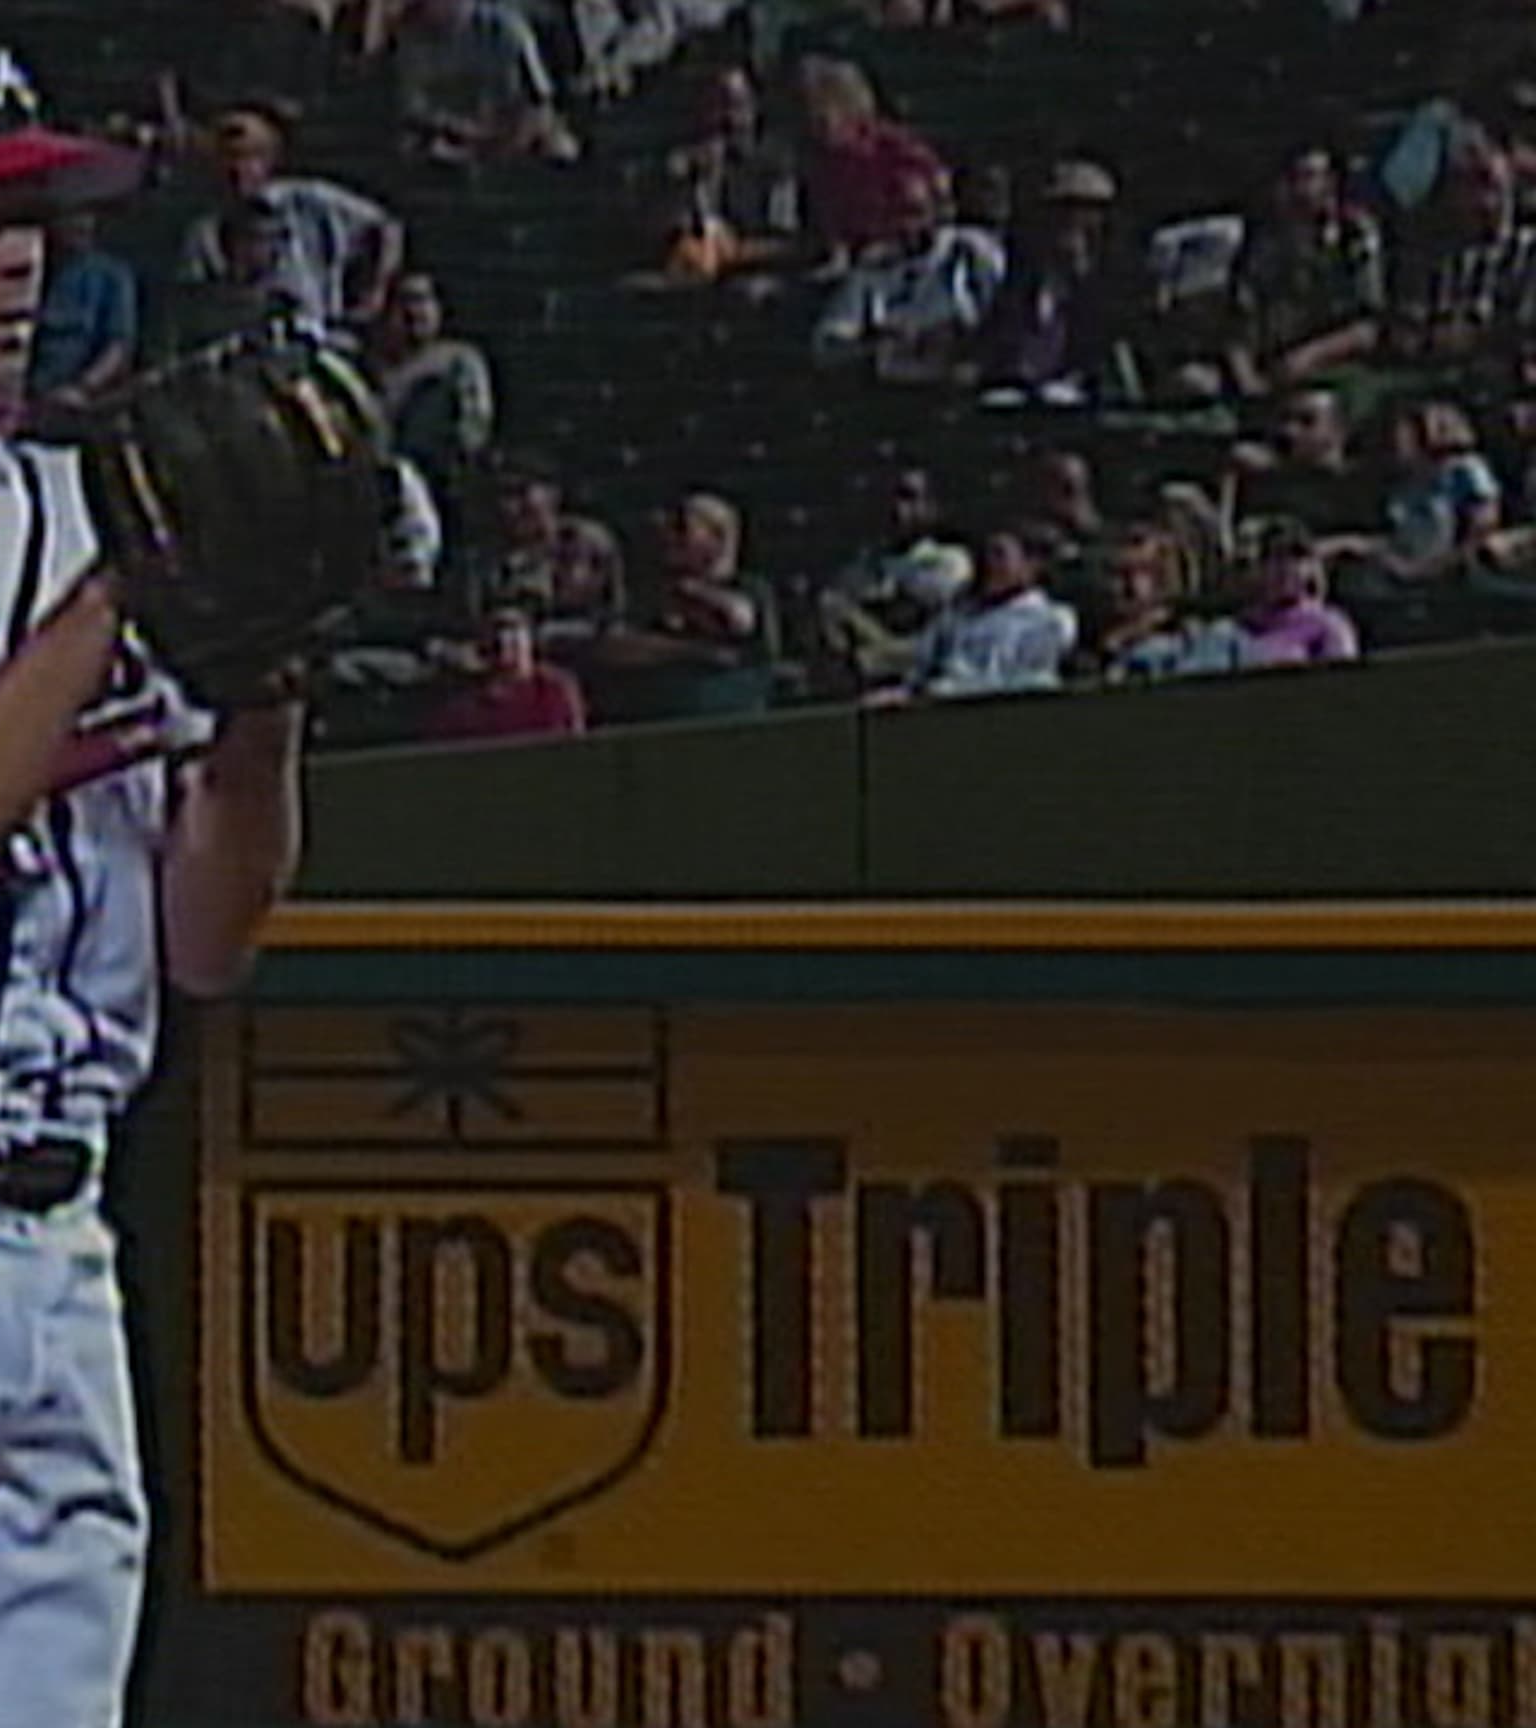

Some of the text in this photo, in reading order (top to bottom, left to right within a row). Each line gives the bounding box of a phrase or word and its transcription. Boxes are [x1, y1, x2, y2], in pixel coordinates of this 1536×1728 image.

[264, 1209, 648, 1465] ups
[714, 1135, 1476, 1468] Triple
[302, 1612, 794, 1728] Ground
